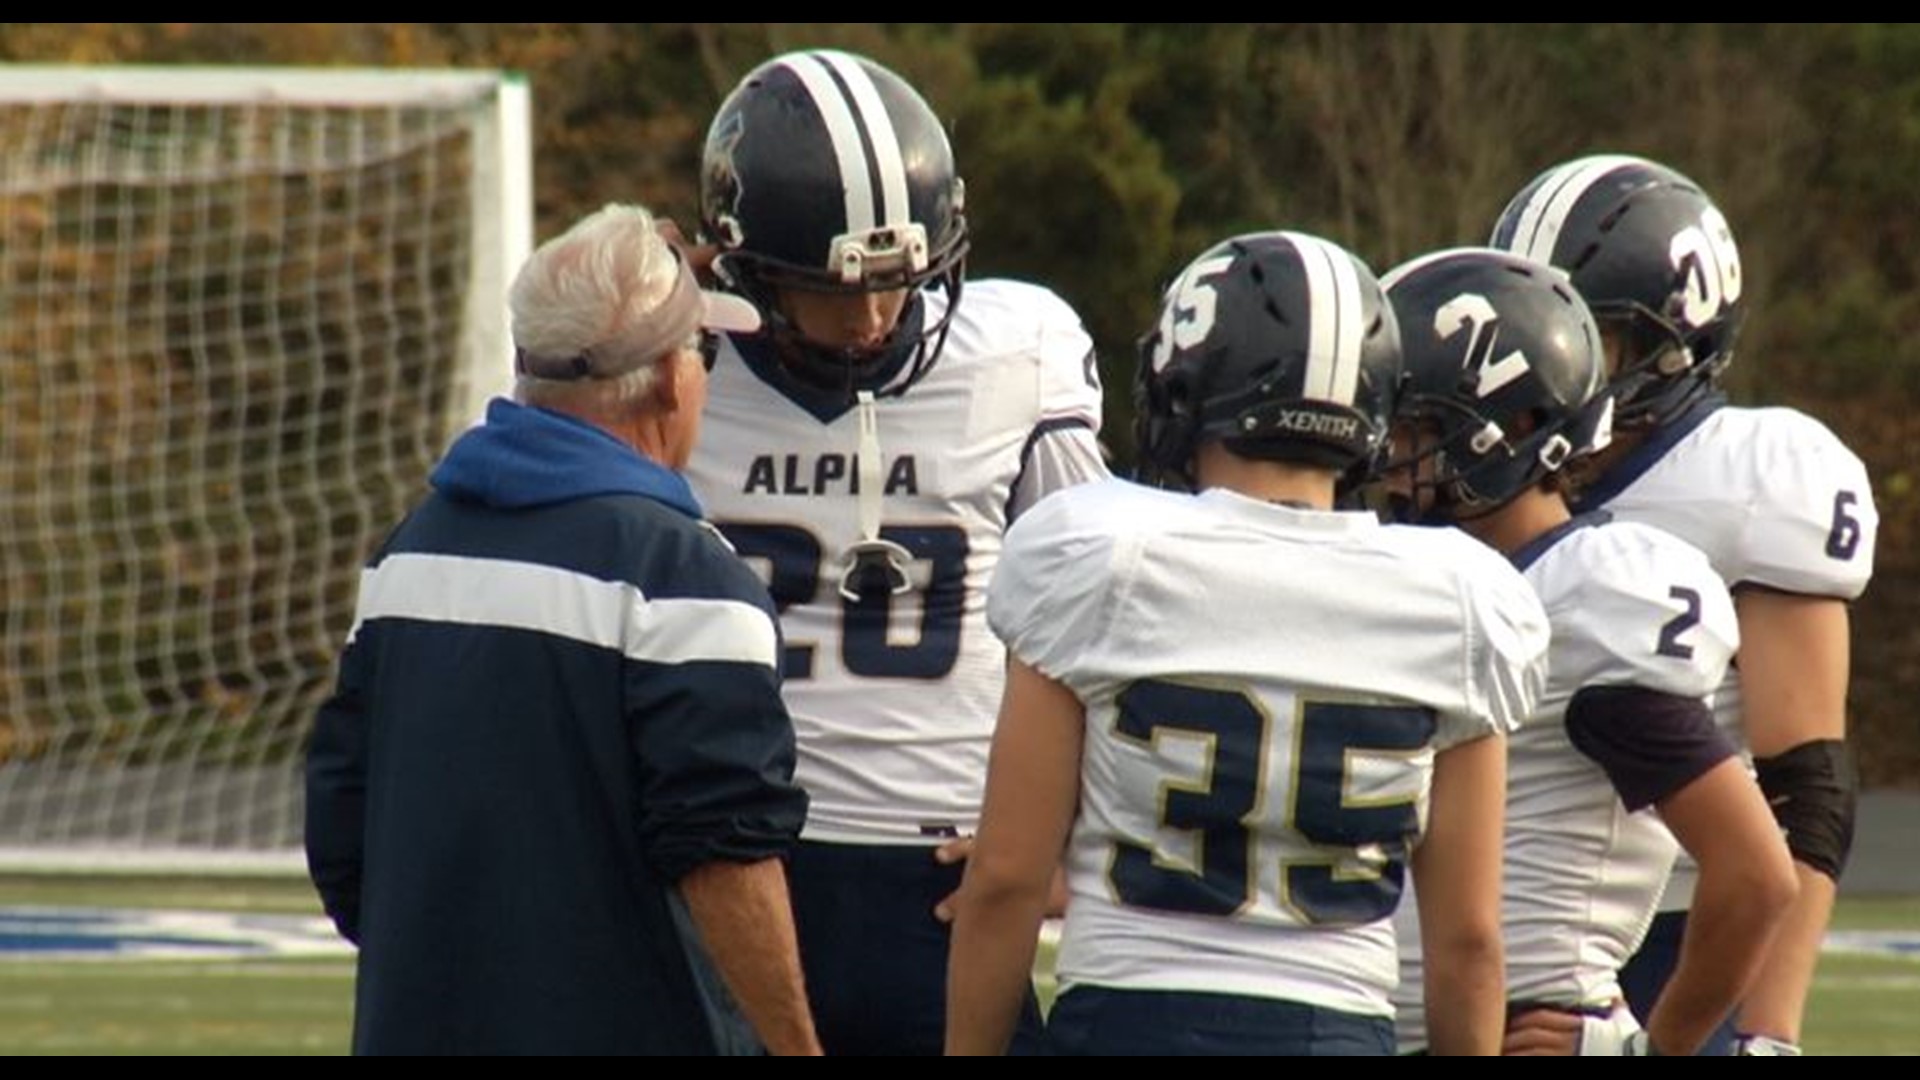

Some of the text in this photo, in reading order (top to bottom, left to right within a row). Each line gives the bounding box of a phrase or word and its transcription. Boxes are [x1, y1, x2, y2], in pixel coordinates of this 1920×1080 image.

[1434, 292, 1530, 398] 2
[1276, 409, 1358, 440] XENITH
[1825, 488, 1861, 562] 6
[1655, 585, 1701, 660] 2
[1105, 675, 1438, 928] 35
